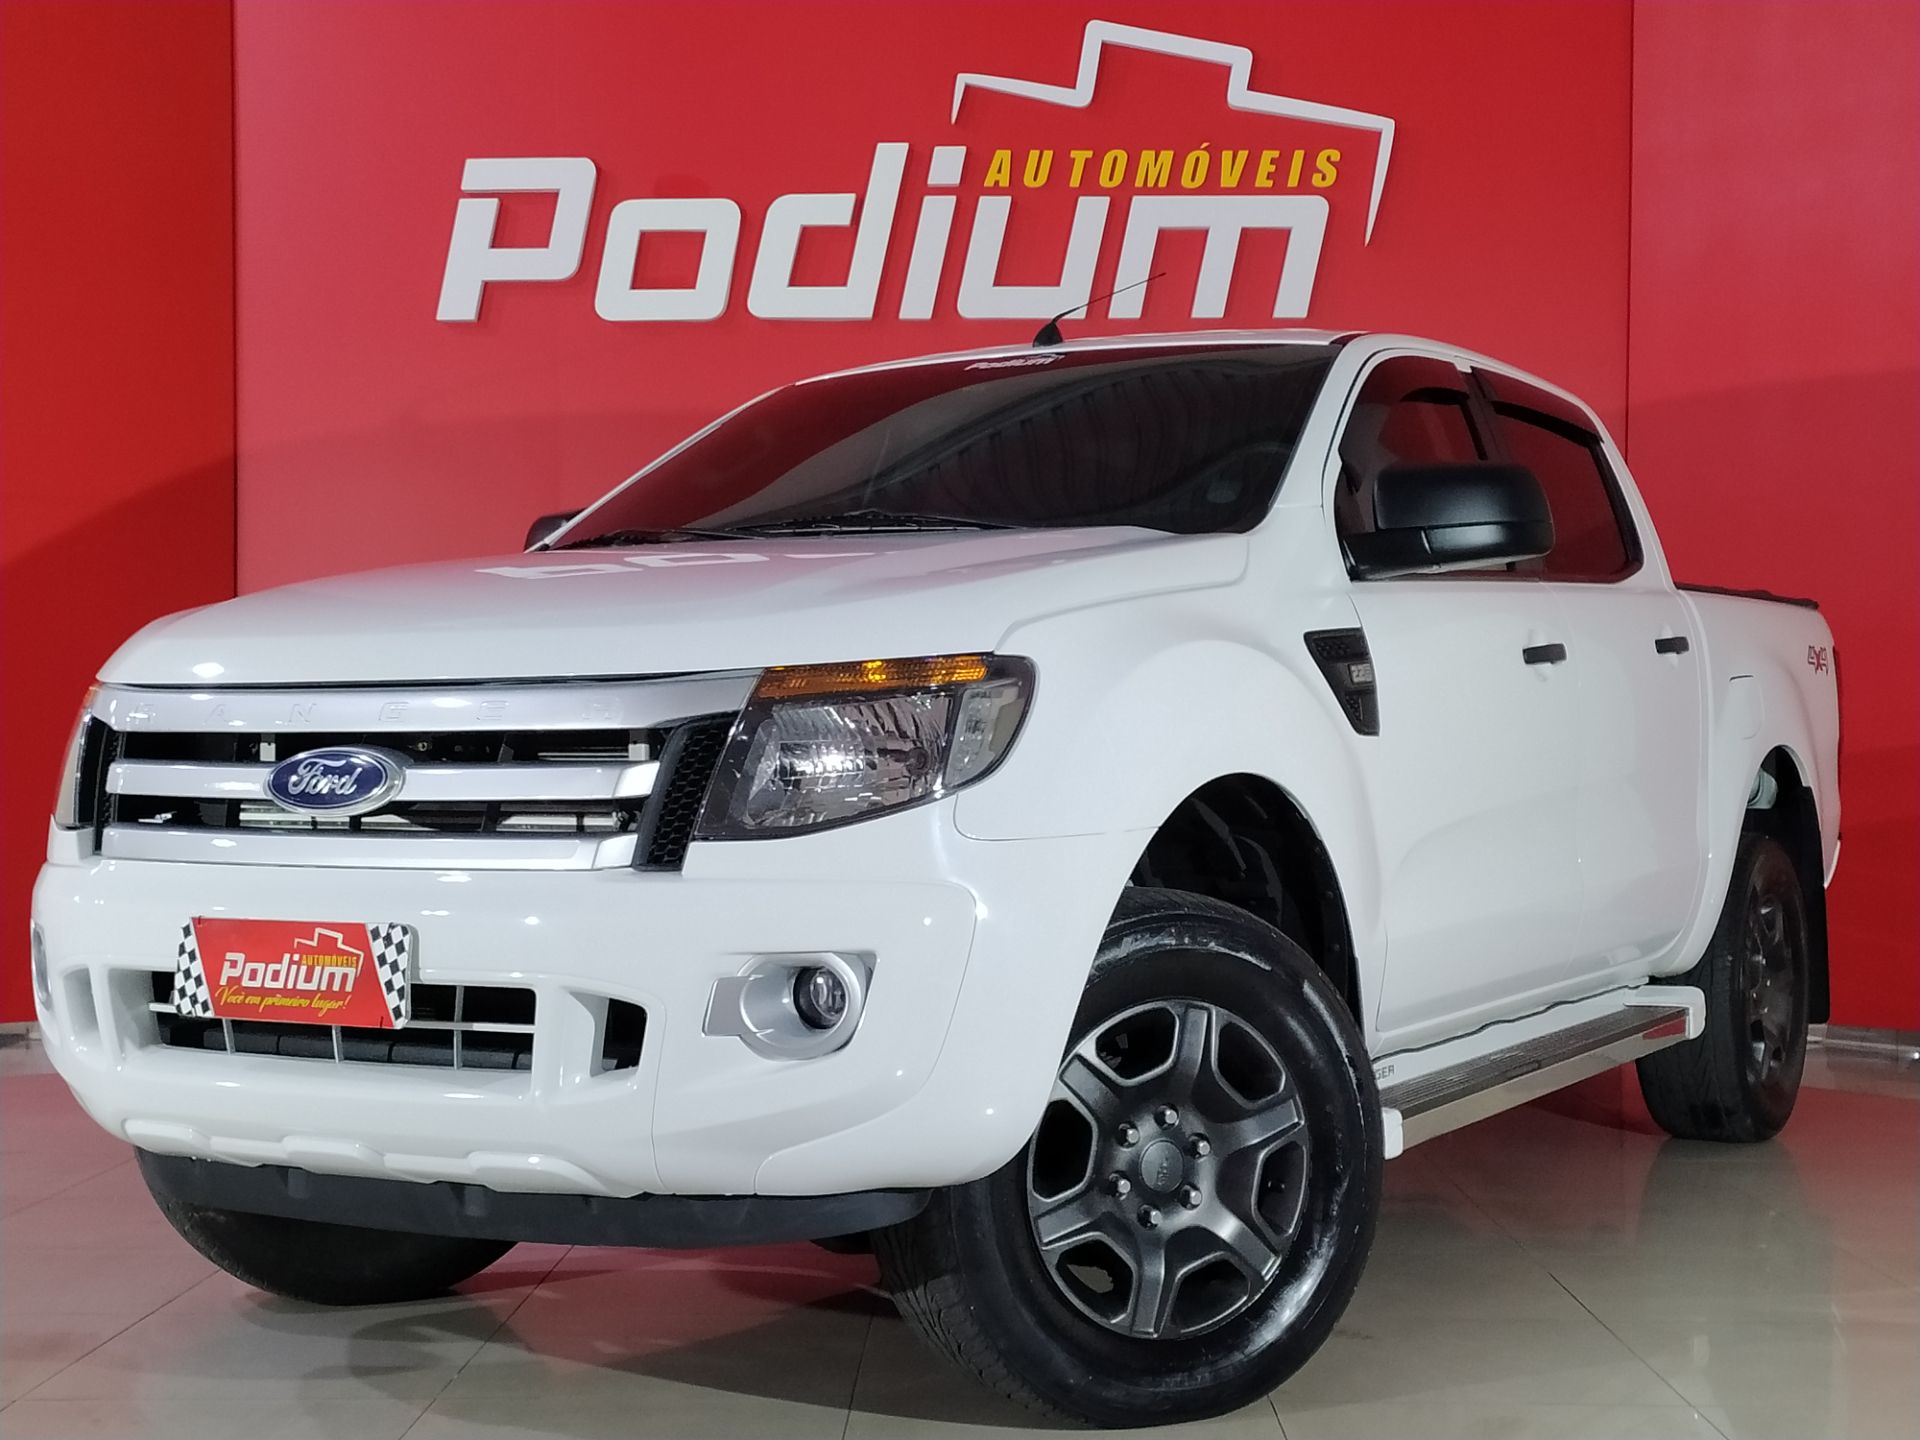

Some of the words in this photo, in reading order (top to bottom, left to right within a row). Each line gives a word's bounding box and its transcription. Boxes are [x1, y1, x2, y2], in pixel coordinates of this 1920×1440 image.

[984, 143, 1343, 189] AUTOMÓVEIS
[436, 142, 1329, 323] Podium
[288, 758, 363, 795] Ford
[219, 952, 356, 992] Podium
[302, 953, 357, 967] AUTOMÓVEIS
[215, 985, 246, 1006] Você
[258, 993, 310, 1013] primeiro
[311, 992, 352, 1017] lugar!
